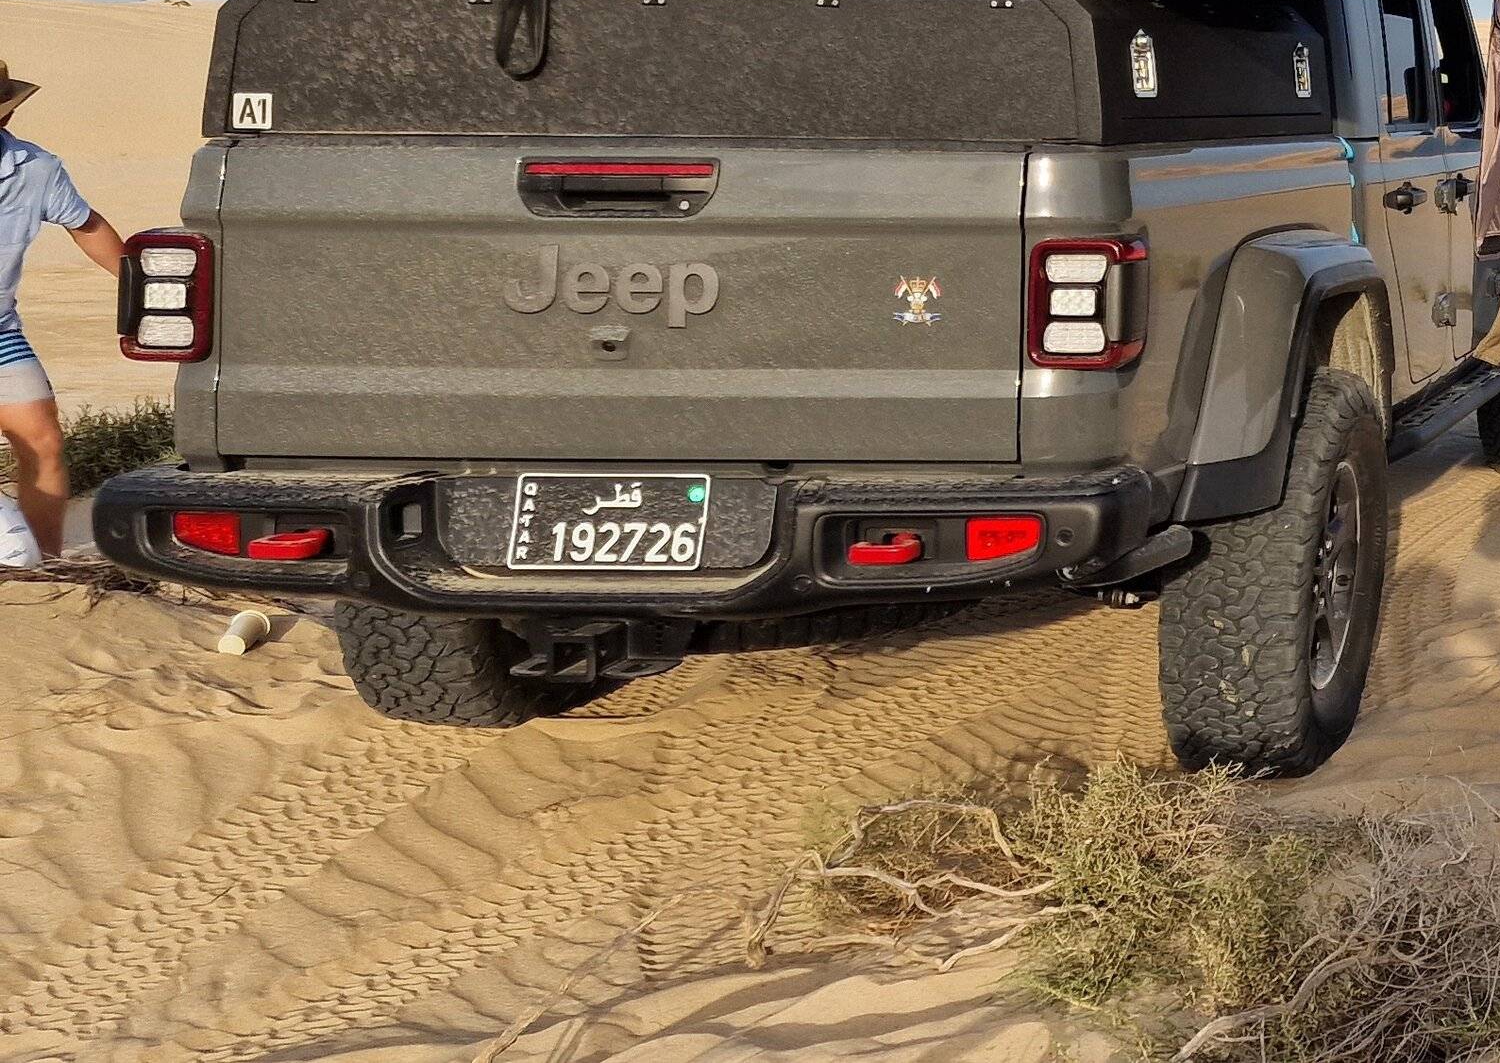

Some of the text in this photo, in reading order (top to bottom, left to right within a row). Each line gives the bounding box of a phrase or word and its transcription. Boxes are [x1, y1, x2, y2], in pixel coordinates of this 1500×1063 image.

[238, 97, 268, 125] A1
[505, 244, 720, 329] Jeep
[582, 481, 643, 515] قطر
[515, 482, 539, 560] QATAR
[551, 521, 697, 563] 192726
